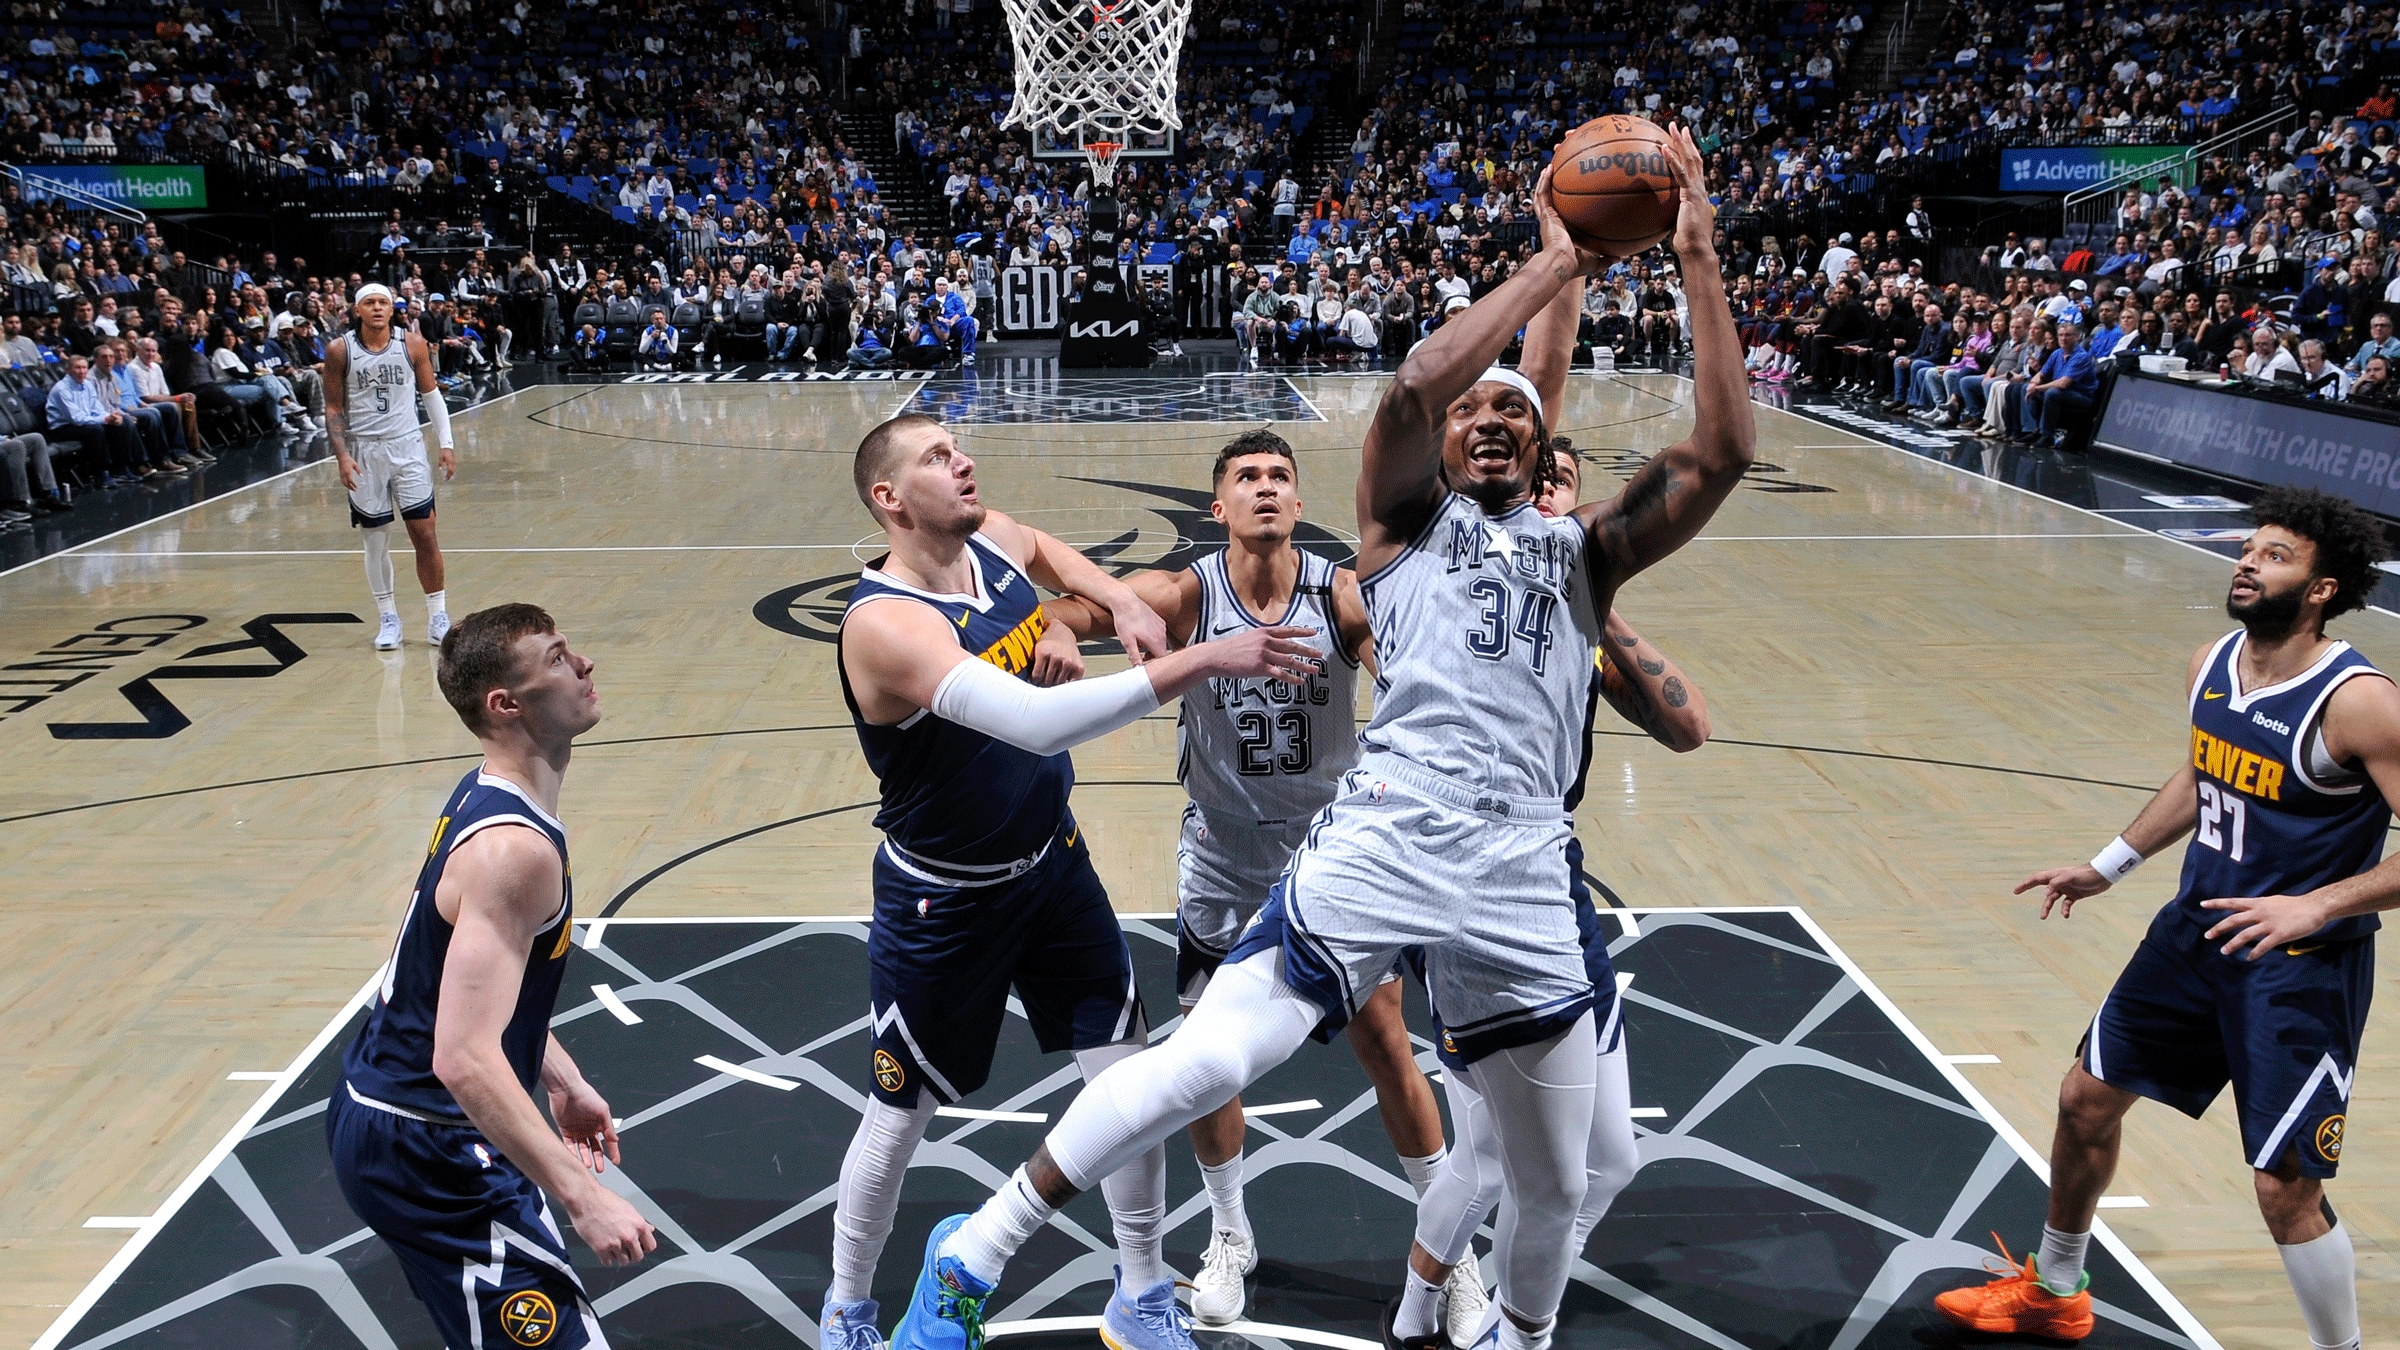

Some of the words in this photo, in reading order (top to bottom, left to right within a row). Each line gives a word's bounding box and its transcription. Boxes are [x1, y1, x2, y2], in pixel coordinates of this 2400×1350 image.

[1579, 151, 1671, 177] Wilson
[2034, 159, 2178, 181] AdventHe
[52, 176, 192, 198] AdventHealth
[1070, 320, 1139, 338] KIA
[621, 367, 937, 383] ORLANDO
[376, 387, 390, 414] 5
[2115, 400, 2197, 441] OFFICIAL
[2199, 414, 2284, 461] HEALTH
[2284, 435, 2353, 477] CARE
[977, 604, 1045, 676] ENVE
[1466, 576, 1557, 678] 34
[0, 614, 209, 722] CENT
[2252, 710, 2291, 736] ibotta
[1236, 709, 1312, 776] 23
[2197, 781, 2245, 862] 27
